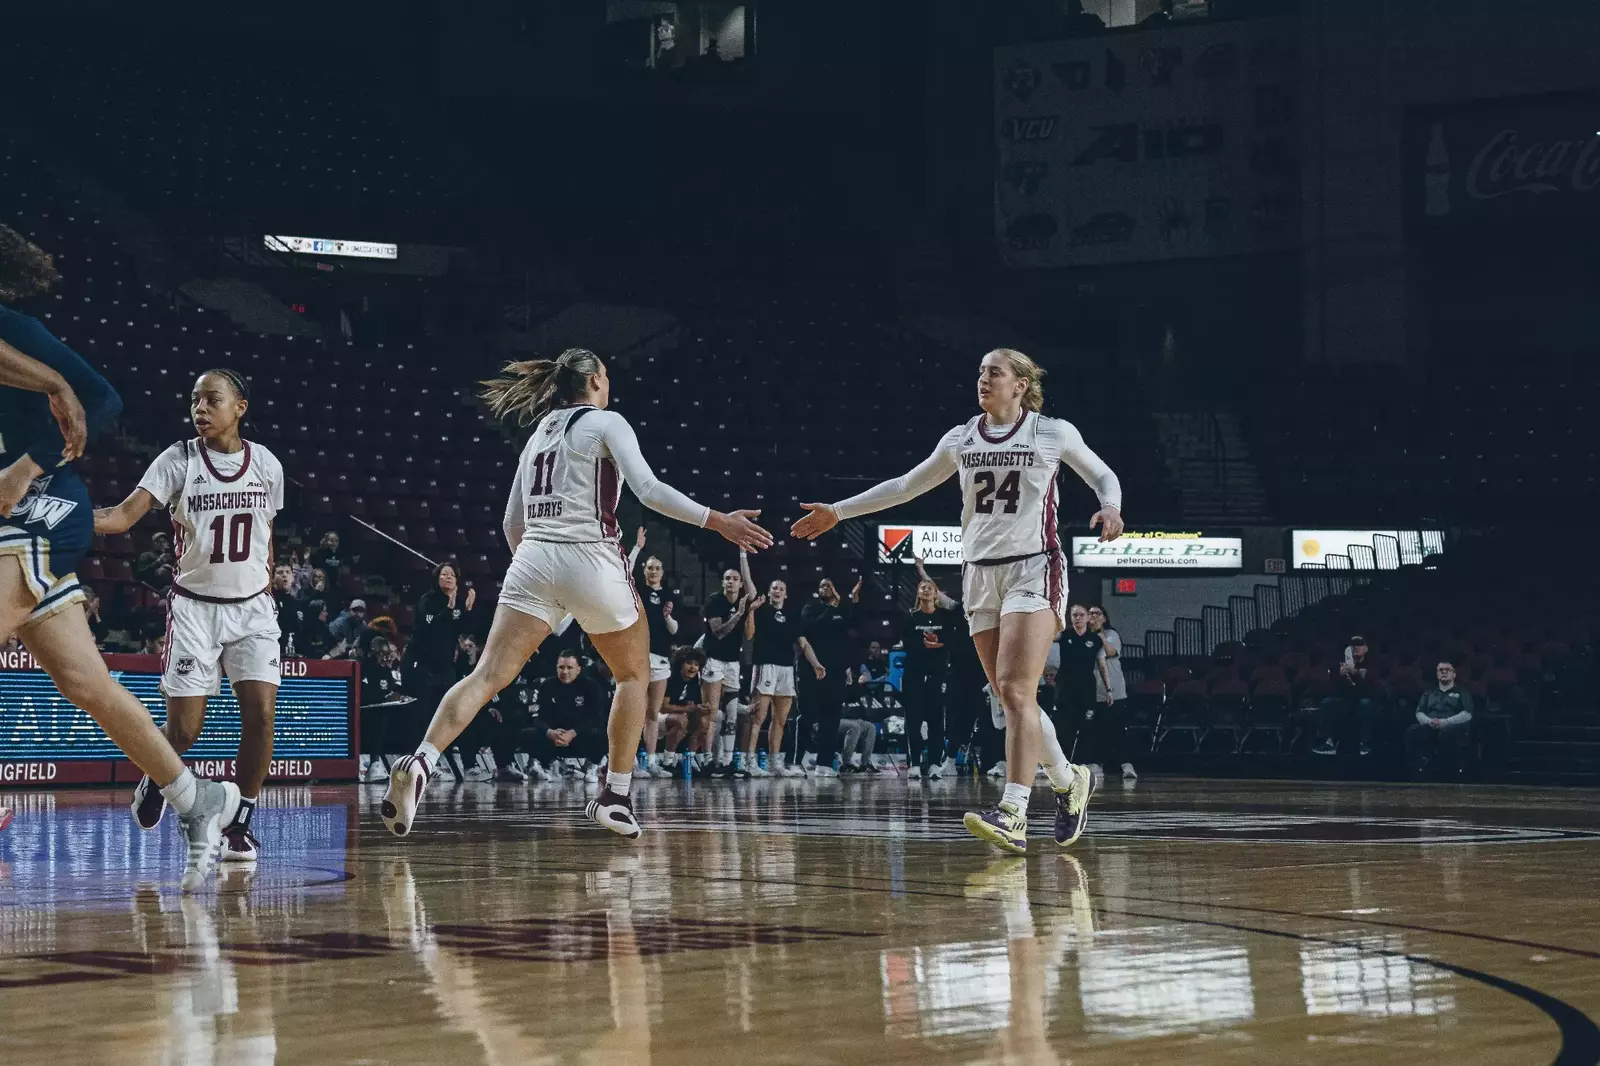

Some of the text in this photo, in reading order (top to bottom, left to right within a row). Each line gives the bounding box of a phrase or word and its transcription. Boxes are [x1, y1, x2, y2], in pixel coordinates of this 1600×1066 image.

[960, 451, 1035, 469] MASSACHUSETTS
[530, 451, 557, 496] 11
[973, 470, 1021, 514] 24
[187, 491, 267, 513] MASSACHUSETTS
[209, 512, 253, 564] 10
[922, 531, 962, 543] All Sta
[921, 547, 964, 559] Materi
[1074, 543, 1239, 556] Peter Pan
[1116, 556, 1199, 566] peterpanbus.com
[194, 760, 313, 777] MGM SGFIELD
